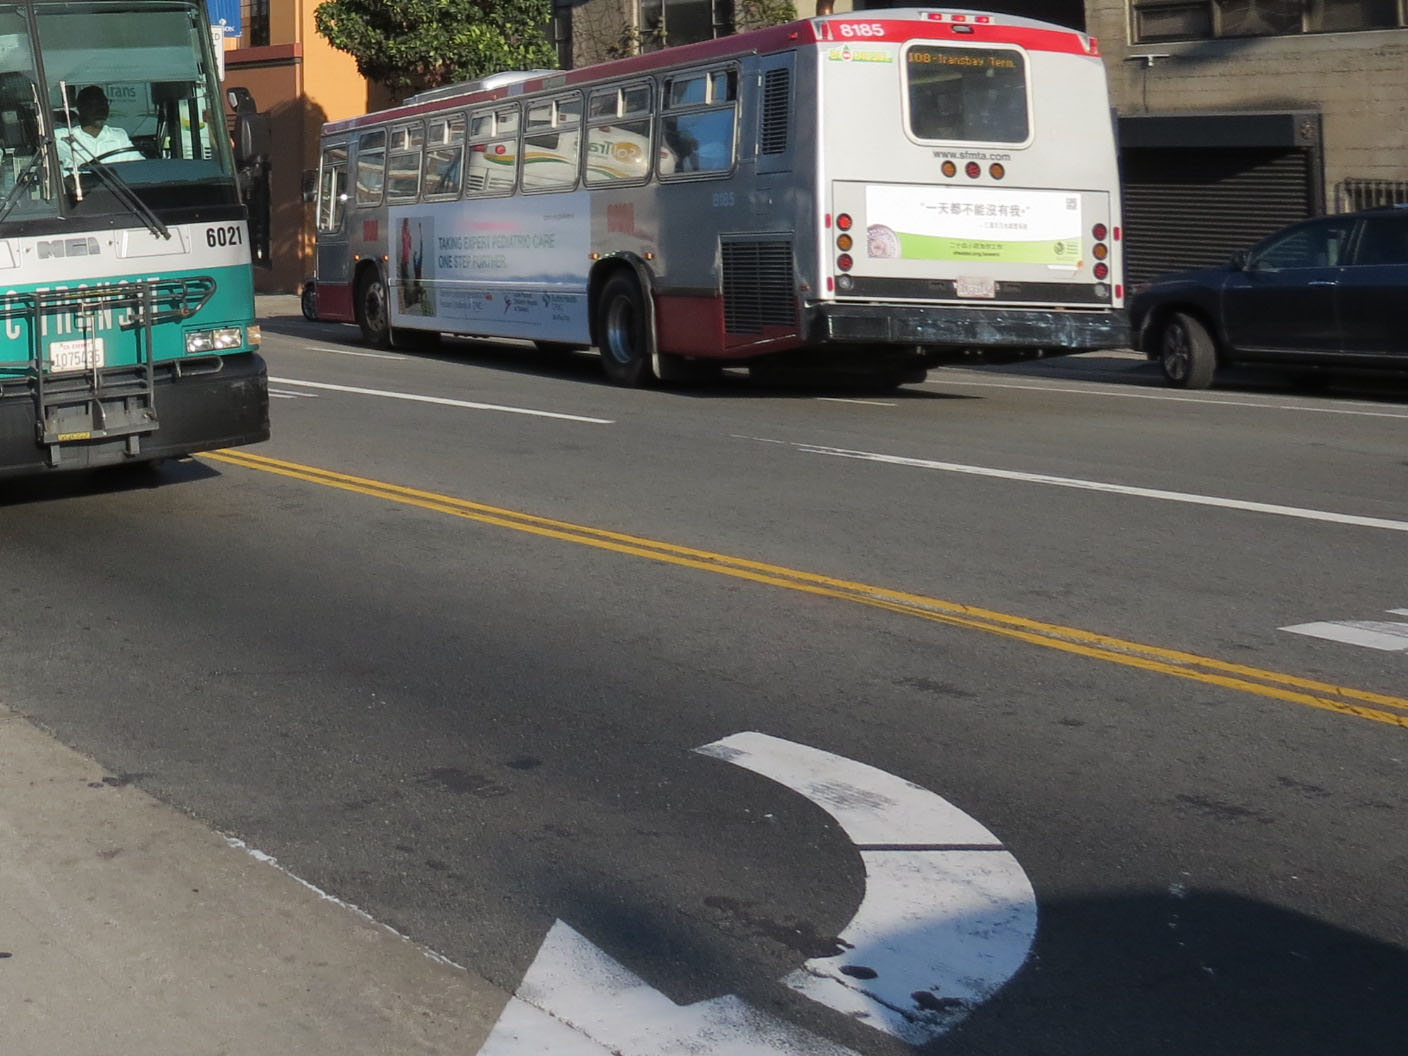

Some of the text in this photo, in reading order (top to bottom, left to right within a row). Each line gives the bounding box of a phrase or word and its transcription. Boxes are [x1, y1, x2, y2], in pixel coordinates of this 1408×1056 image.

[840, 23, 886, 37] 8185
[932, 150, 1012, 162] www.sfmta.com
[206, 226, 243, 248] 6021
[532, 234, 555, 248] CARE
[438, 255, 453, 269] ONE
[454, 255, 470, 269] STEP
